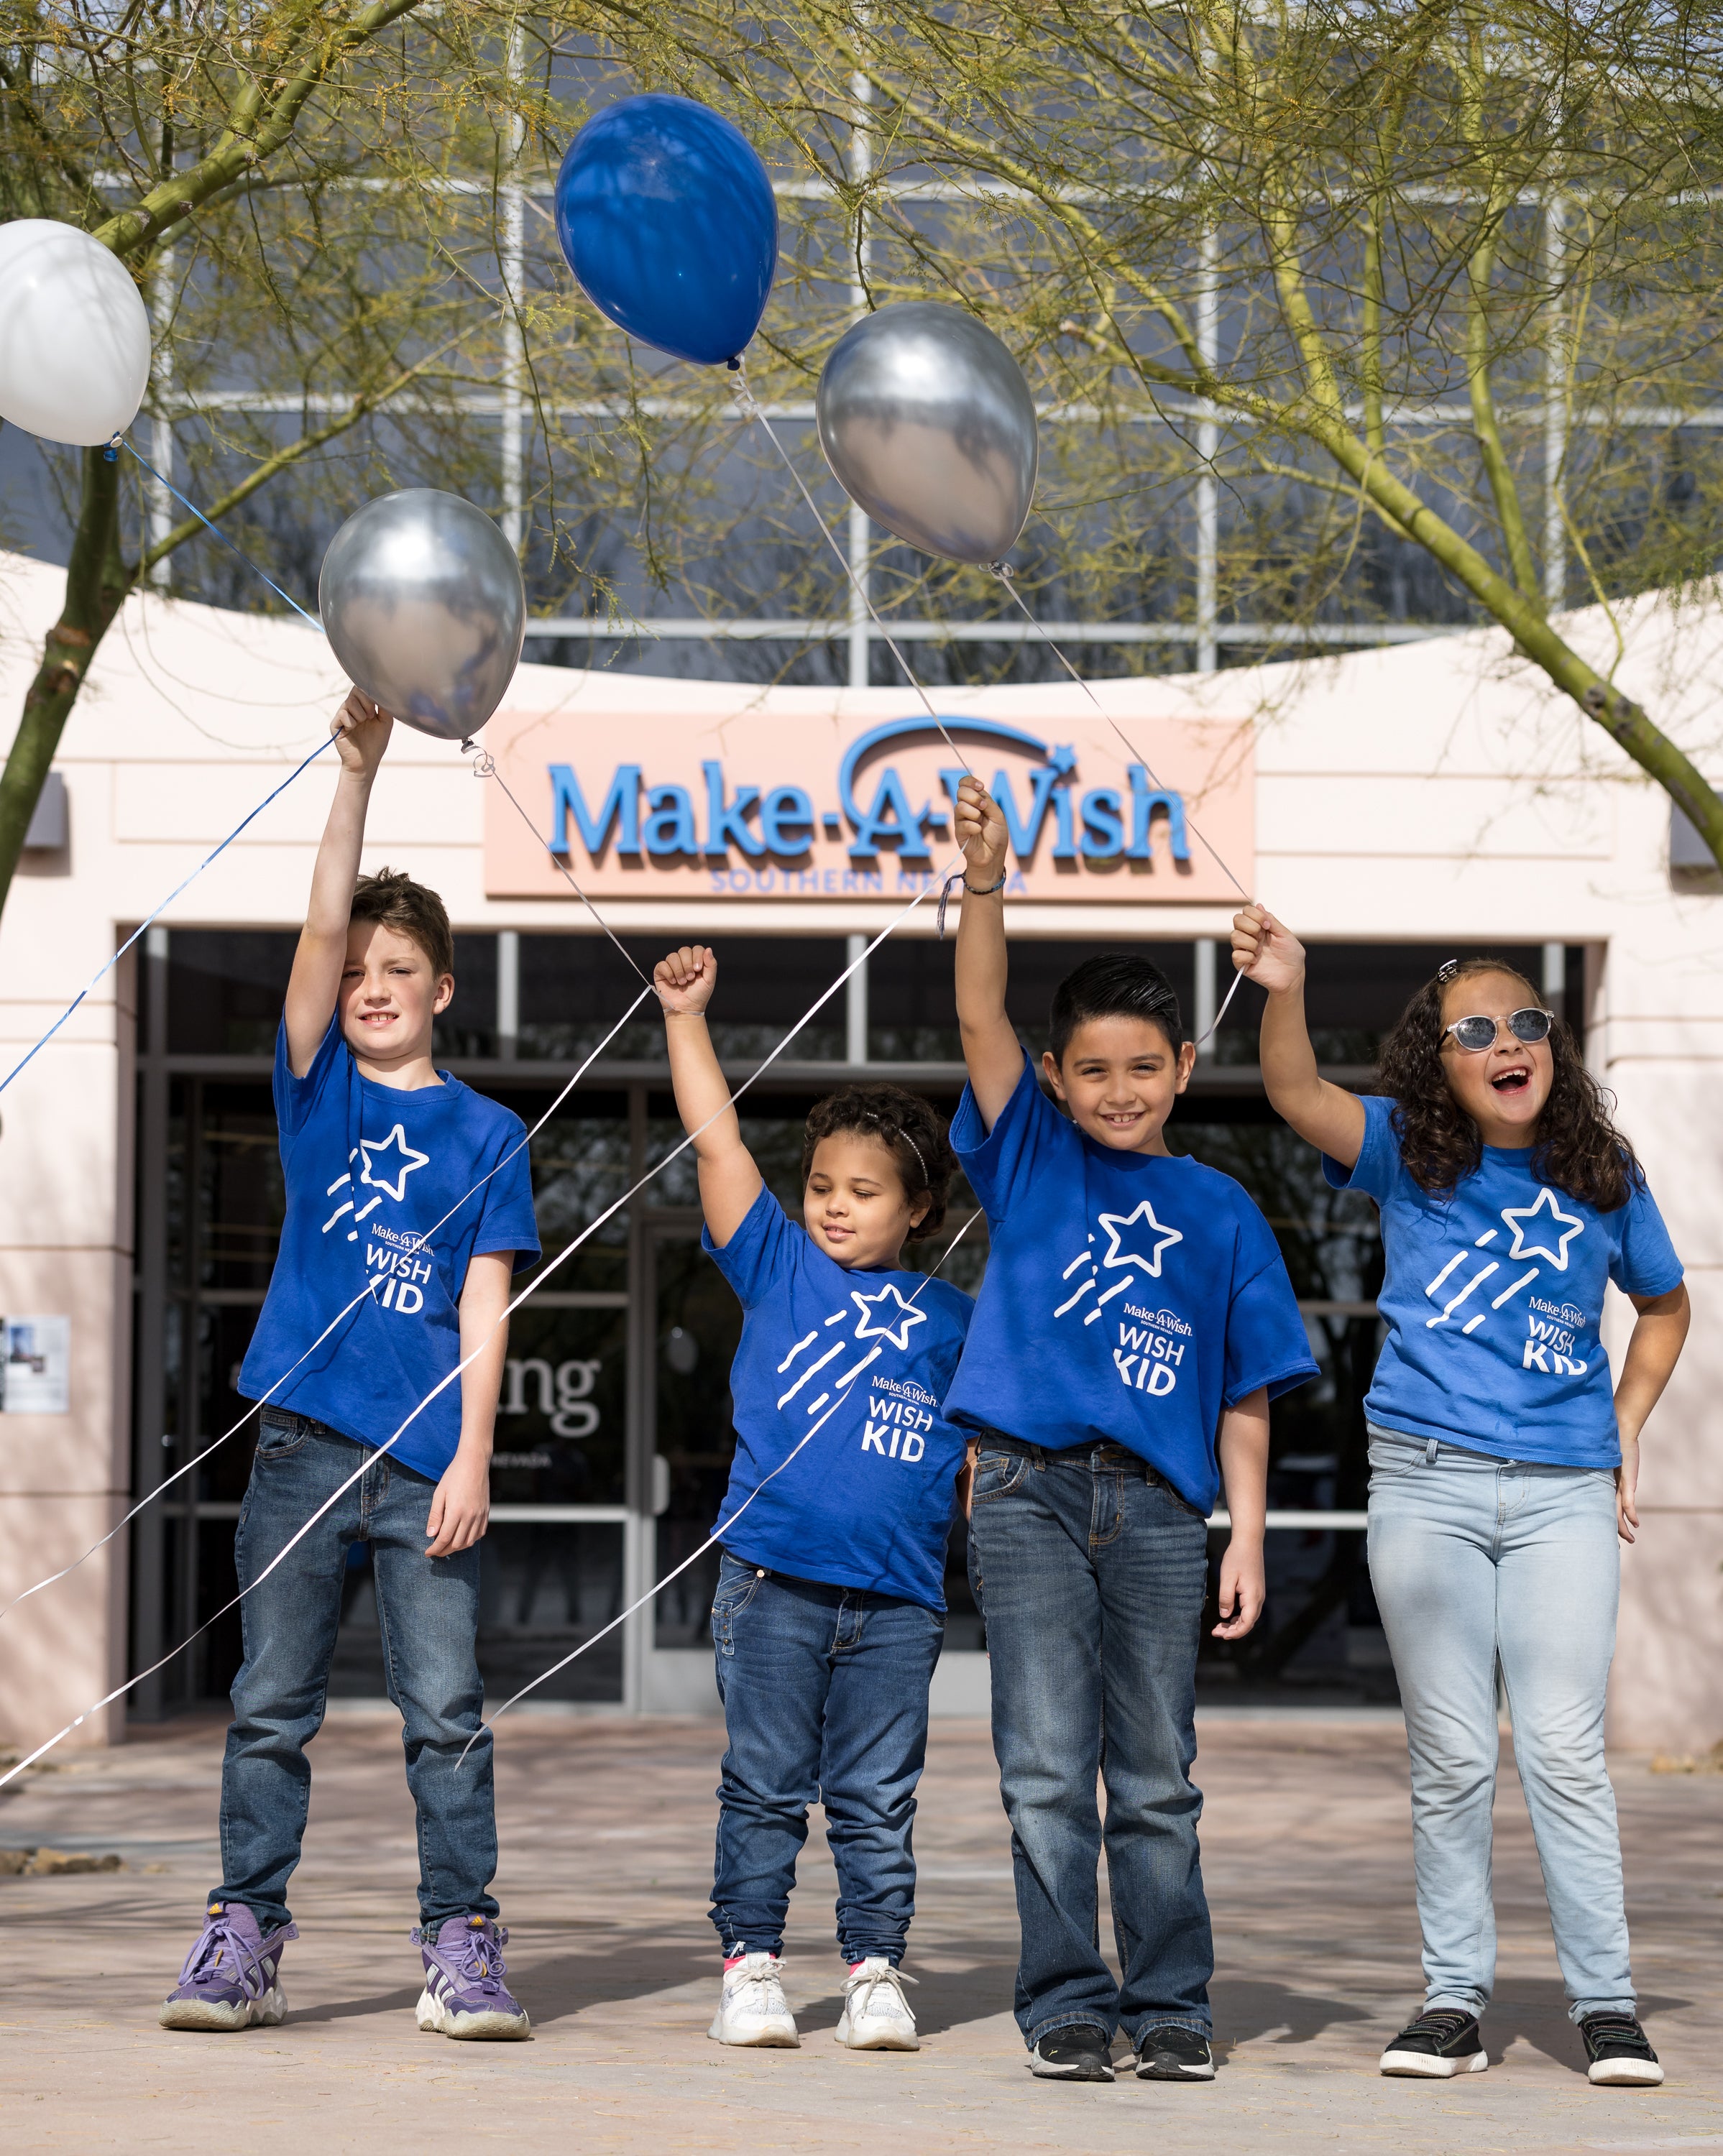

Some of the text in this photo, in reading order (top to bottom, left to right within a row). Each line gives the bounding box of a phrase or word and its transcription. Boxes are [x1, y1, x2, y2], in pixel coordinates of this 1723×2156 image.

[548, 743, 1191, 860] Make-A-Wish
[710, 868, 1027, 894] SOUTHERN NEVA
[367, 1243, 431, 1284] WISH
[1124, 1302, 1193, 1337] Make-A-Wish
[1528, 1314, 1575, 1357] WISH
[1119, 1322, 1185, 1366] WISH
[1522, 1340, 1588, 1376] KID
[871, 1375, 937, 1407] Make-A-Wish
[1113, 1348, 1176, 1396] KID
[869, 1395, 934, 1432] WISH
[861, 1420, 925, 1462] KID
